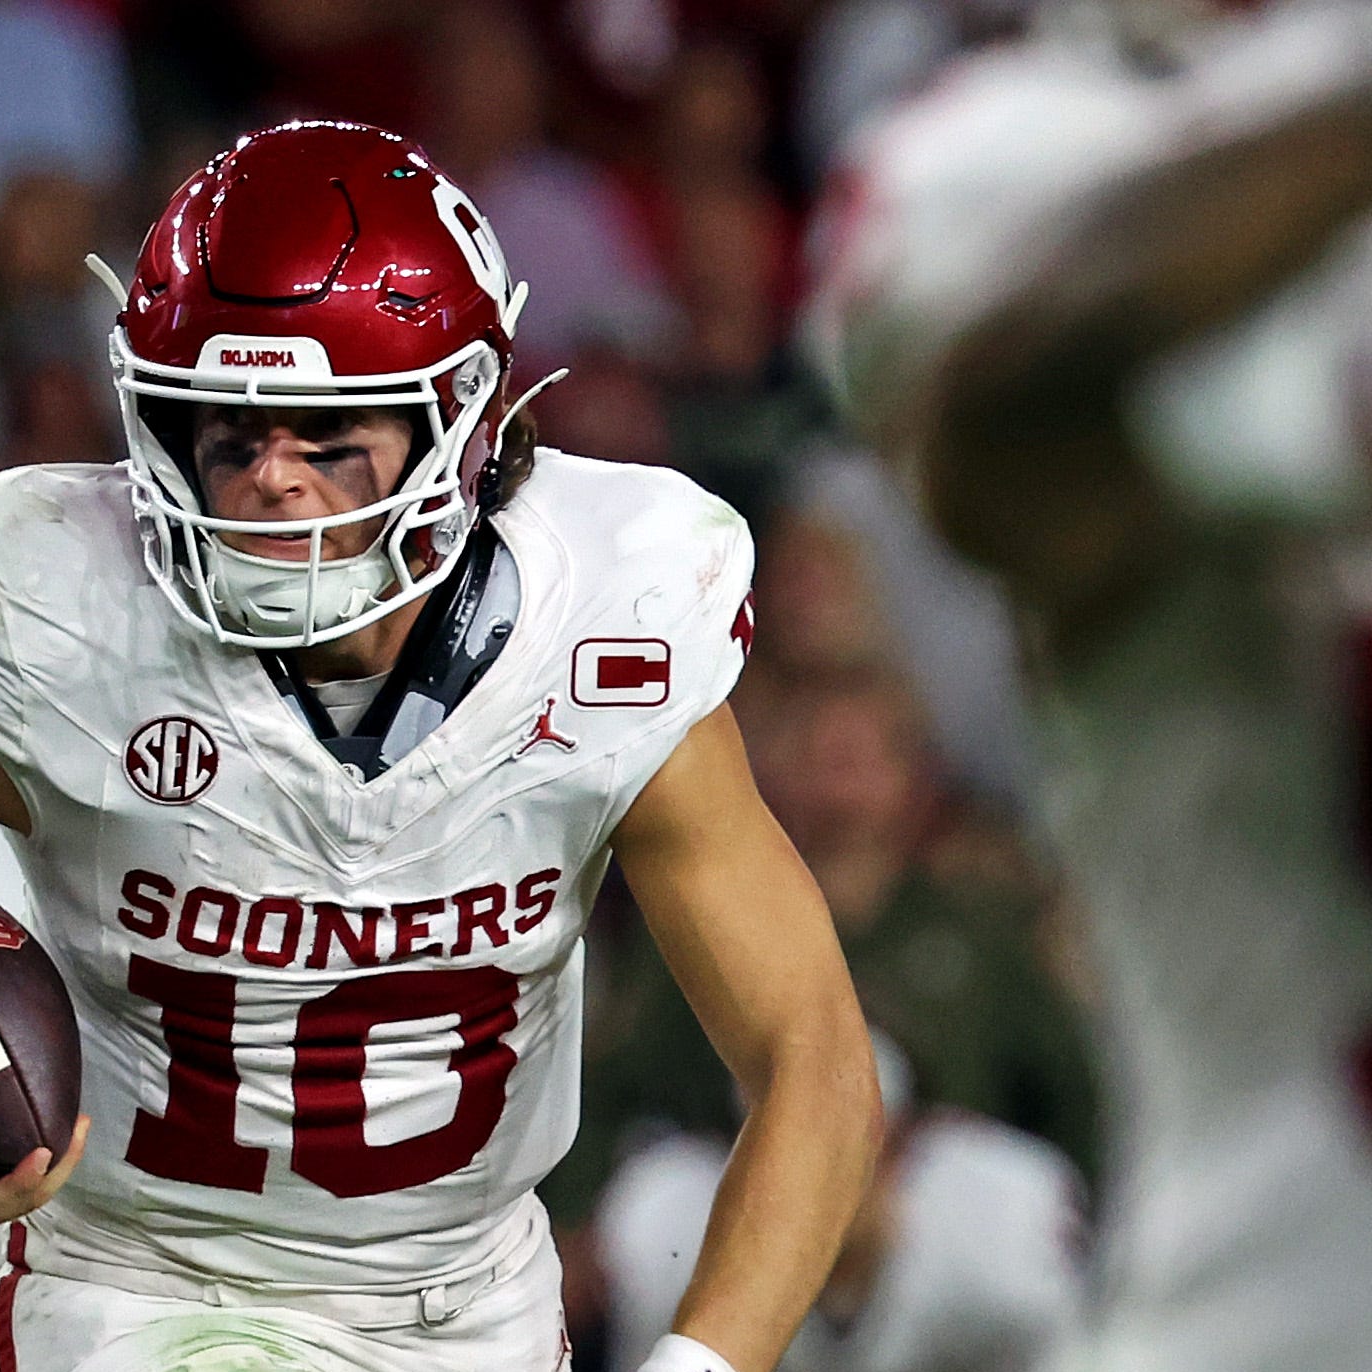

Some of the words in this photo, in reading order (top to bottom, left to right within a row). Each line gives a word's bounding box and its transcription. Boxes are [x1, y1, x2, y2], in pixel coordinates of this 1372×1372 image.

[220, 349, 296, 368] OKLAHOMA
[571, 638, 671, 707] C
[132, 720, 214, 798] SEC
[117, 867, 562, 970] SOONERS
[124, 952, 521, 1199] 10
